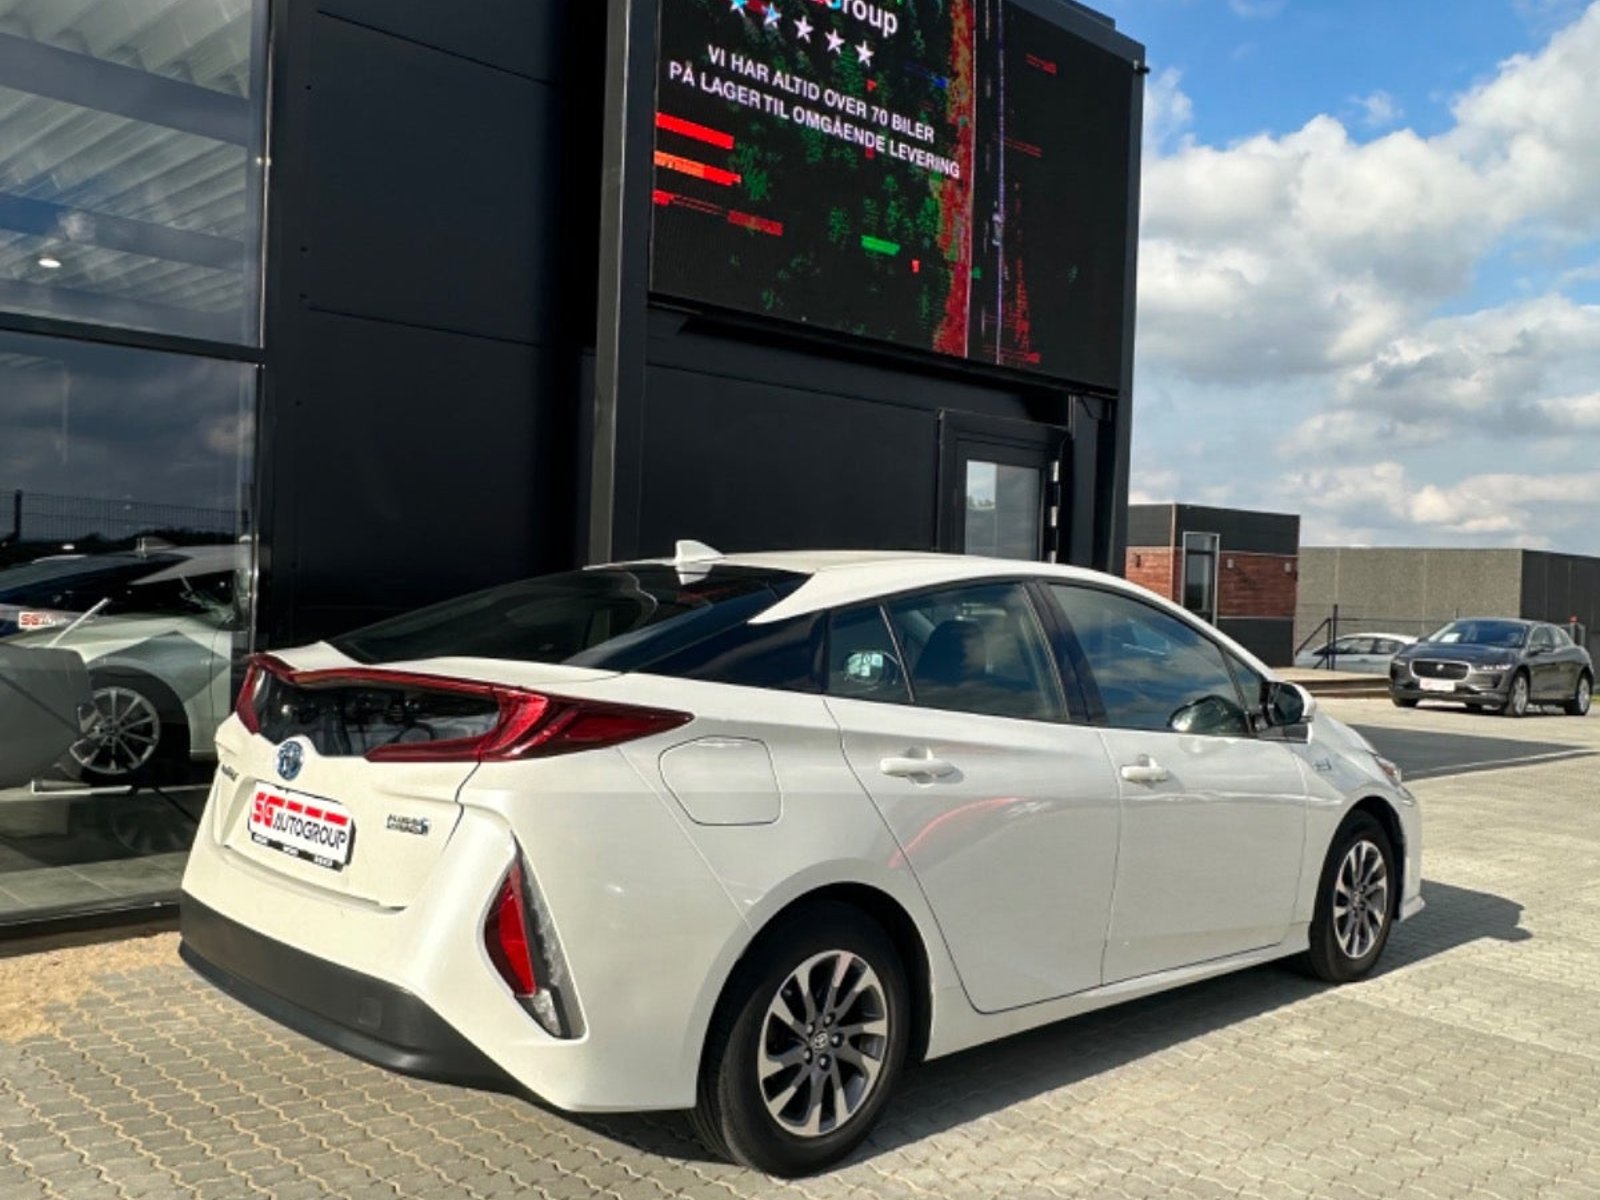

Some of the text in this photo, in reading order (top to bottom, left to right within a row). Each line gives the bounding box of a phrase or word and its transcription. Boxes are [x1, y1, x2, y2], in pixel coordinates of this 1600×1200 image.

[669, 60, 961, 179] PÅ LAGER TIL OMGÅENDE LEVERING
[708, 44, 935, 143] VI HAR ALTID OVER 70 BILER
[273, 811, 348, 850] AUTOGROUP
